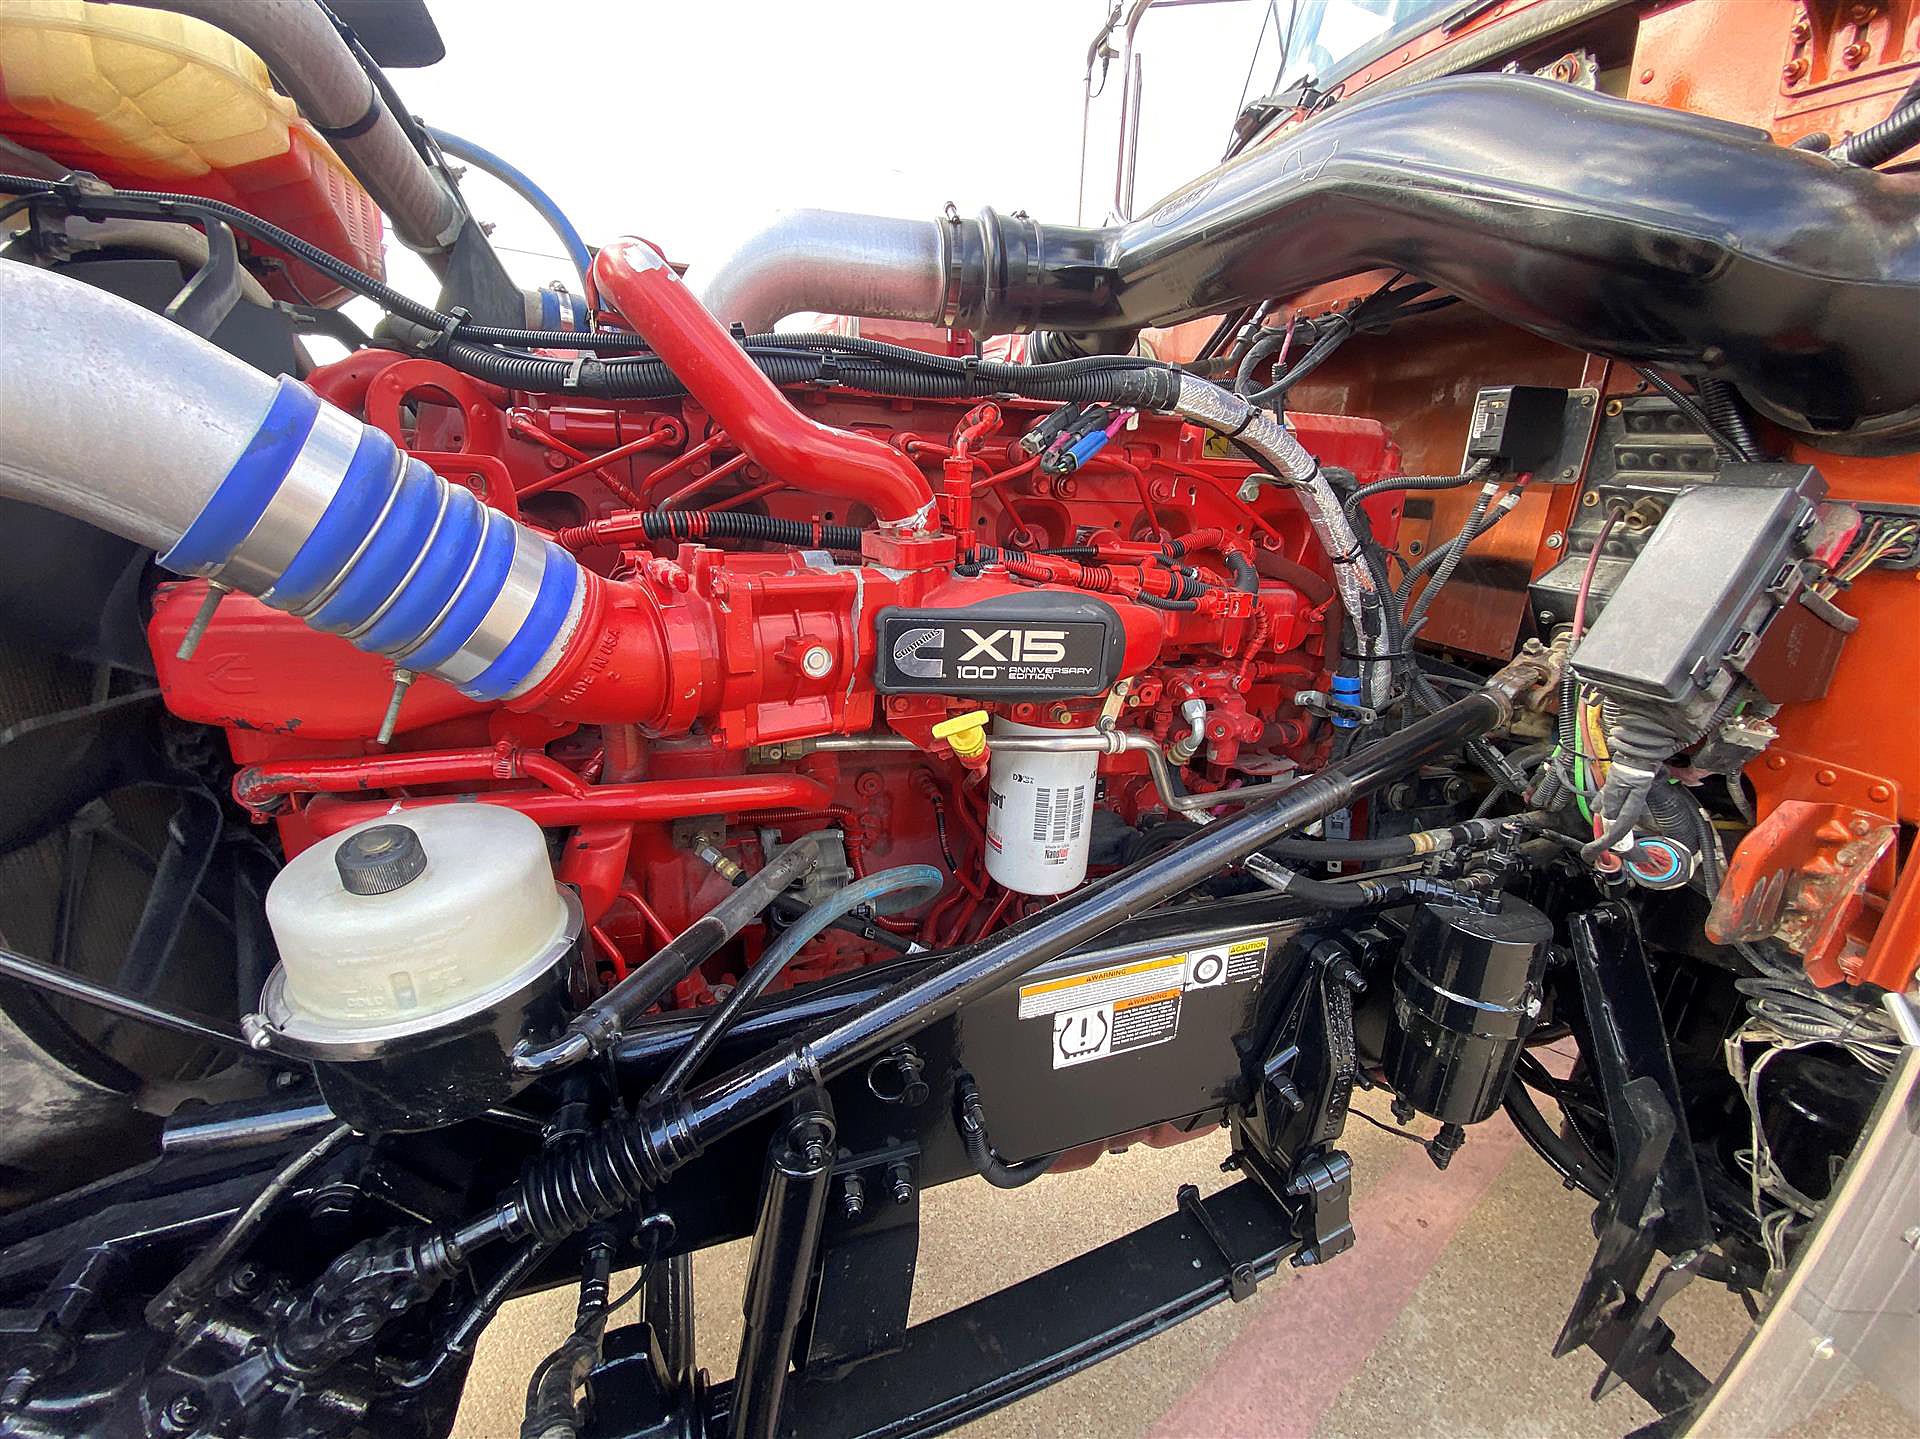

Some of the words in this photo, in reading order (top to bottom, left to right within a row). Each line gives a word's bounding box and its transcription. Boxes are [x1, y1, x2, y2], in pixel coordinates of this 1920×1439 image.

[894, 629, 941, 659] Cummins
[957, 629, 1067, 662] X15
[560, 672, 595, 704] MADE
[590, 655, 609, 674] IN
[600, 629, 621, 655] USA
[1009, 666, 1093, 675] ANNIVERSARY
[1235, 941, 1266, 953] CAUTION
[1091, 968, 1126, 981] WARNING
[1134, 992, 1168, 1004] WARNING
